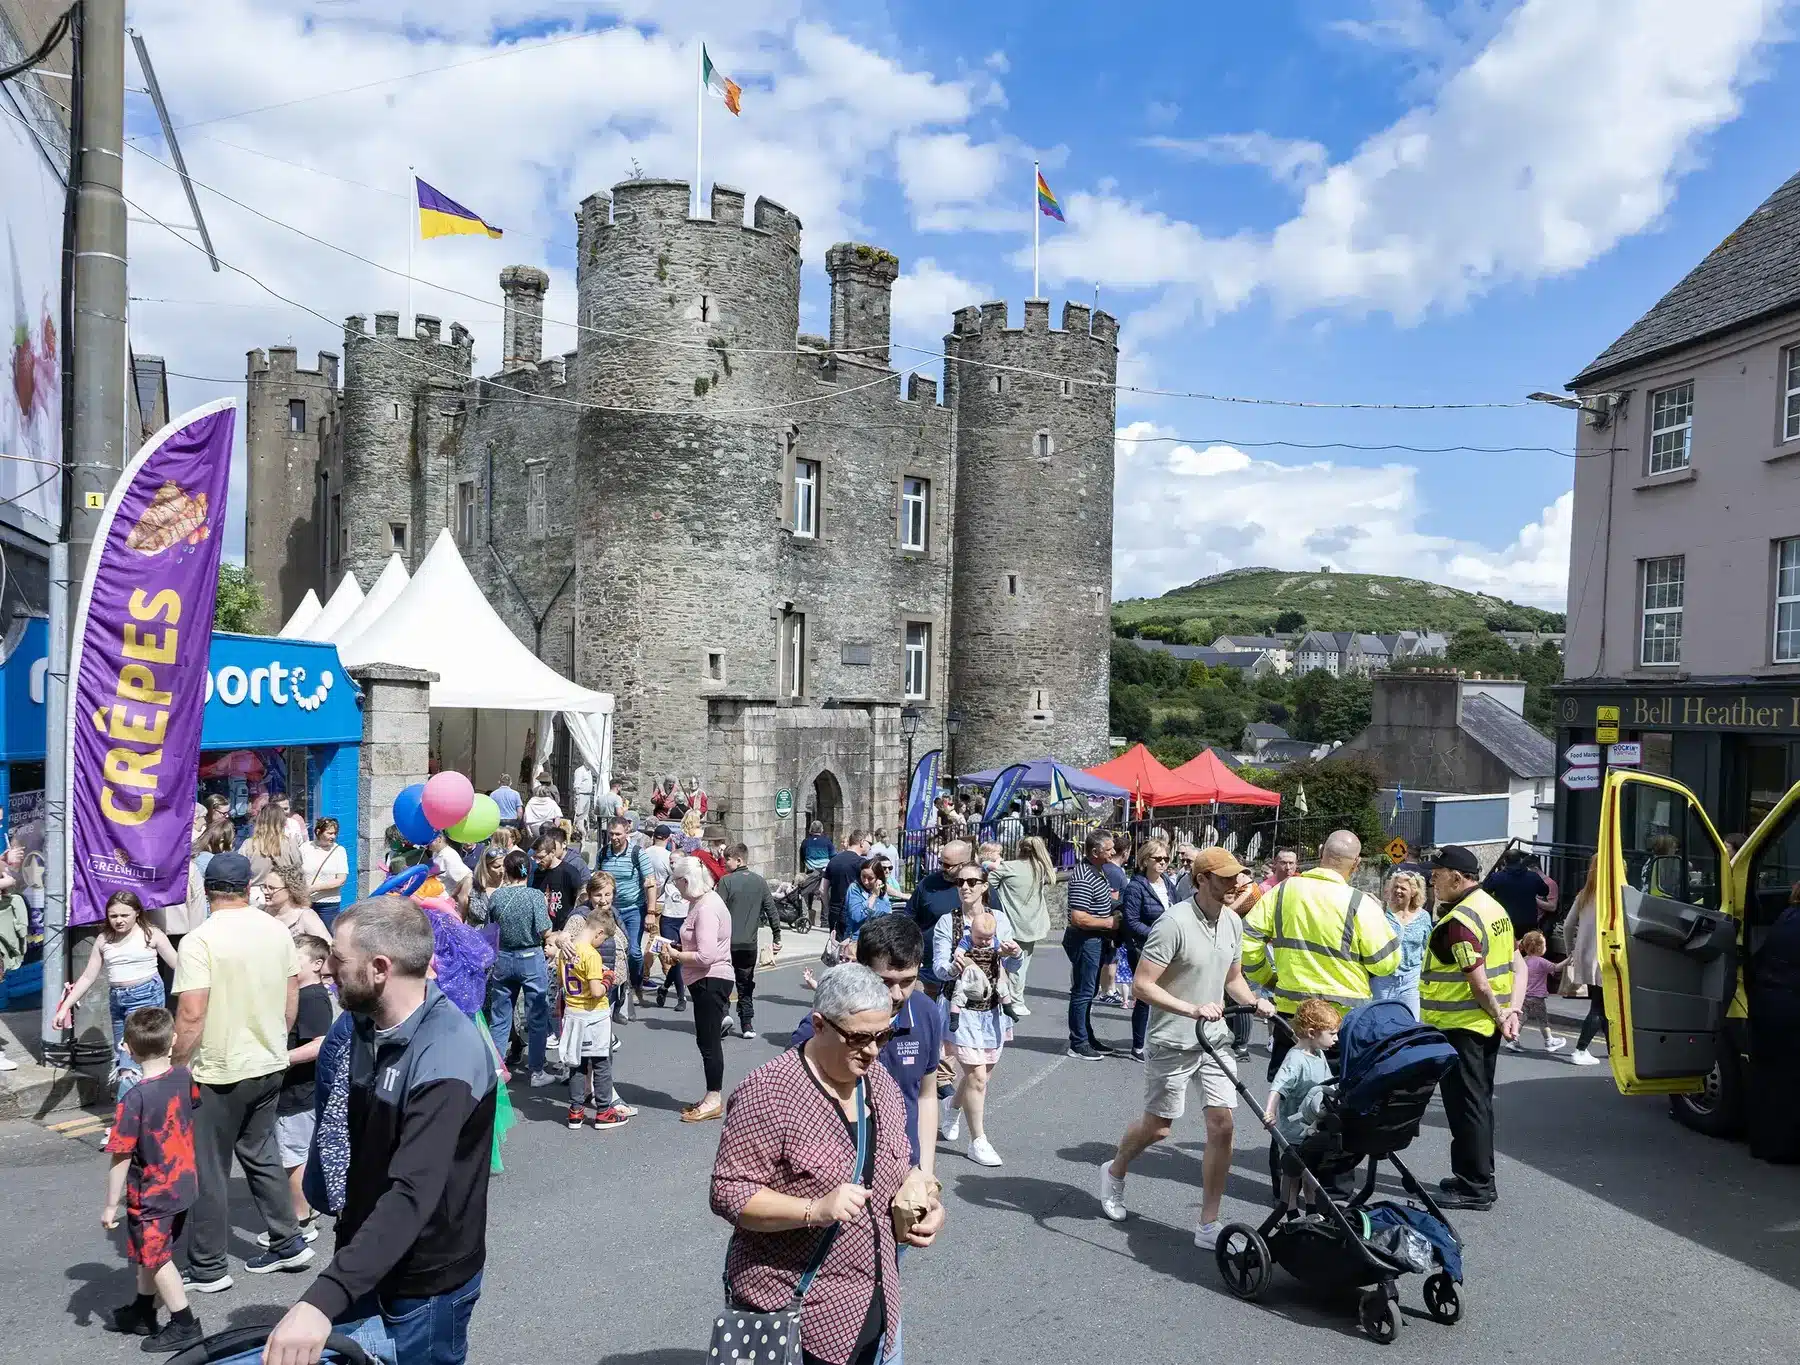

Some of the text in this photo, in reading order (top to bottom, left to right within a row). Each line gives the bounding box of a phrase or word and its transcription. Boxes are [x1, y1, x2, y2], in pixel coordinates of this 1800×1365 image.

[90, 495, 98, 507] 1
[205, 661, 289, 705] ort
[92, 587, 182, 827] CRÊPES
[1633, 697, 1672, 724] Bell
[1682, 697, 1784, 727] Heather
[8, 791, 43, 807] rophy &
[8, 808, 45, 824] ngraving
[8, 824, 34, 837] ervice
[564, 963, 582, 996] 6
